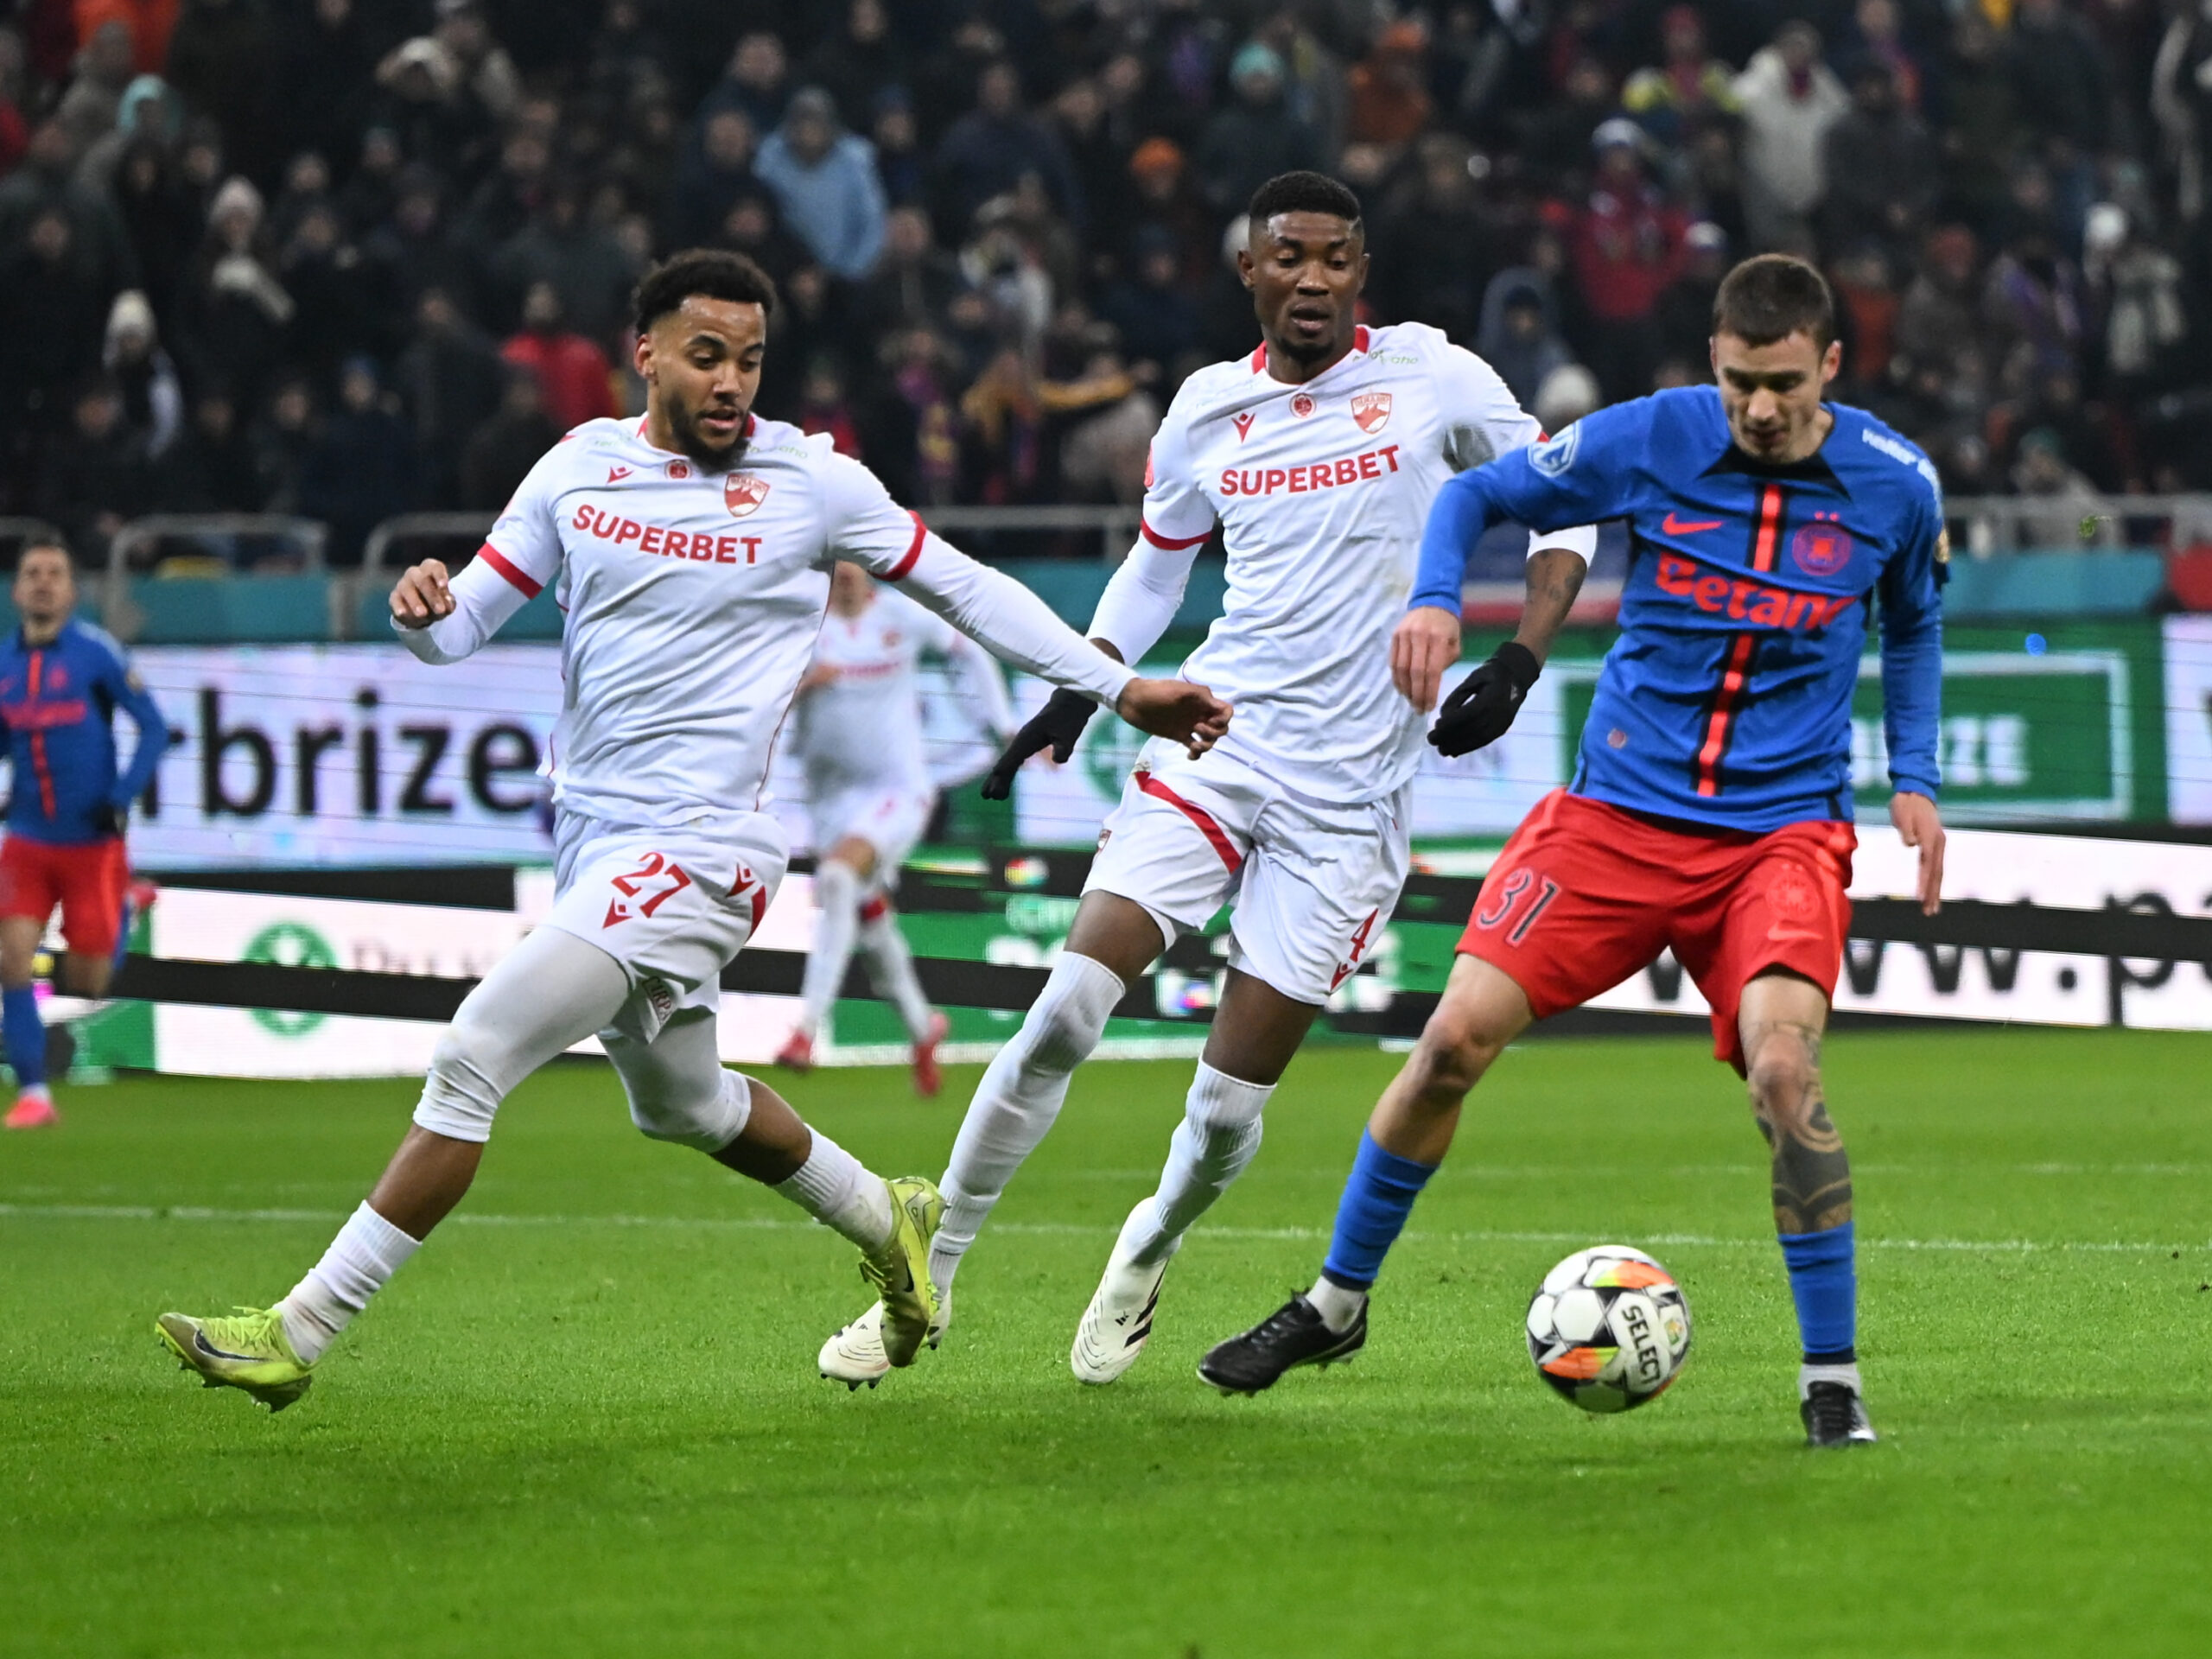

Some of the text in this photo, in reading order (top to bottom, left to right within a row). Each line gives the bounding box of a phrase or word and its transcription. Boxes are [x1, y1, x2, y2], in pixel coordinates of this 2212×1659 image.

[1219, 444, 1400, 497] SUPERBET
[572, 504, 763, 564] SUPERBET
[610, 851, 691, 919] 27
[1475, 867, 1562, 949] 31
[1349, 907, 1380, 963] 4
[1621, 1305, 1661, 1382] SELECT
